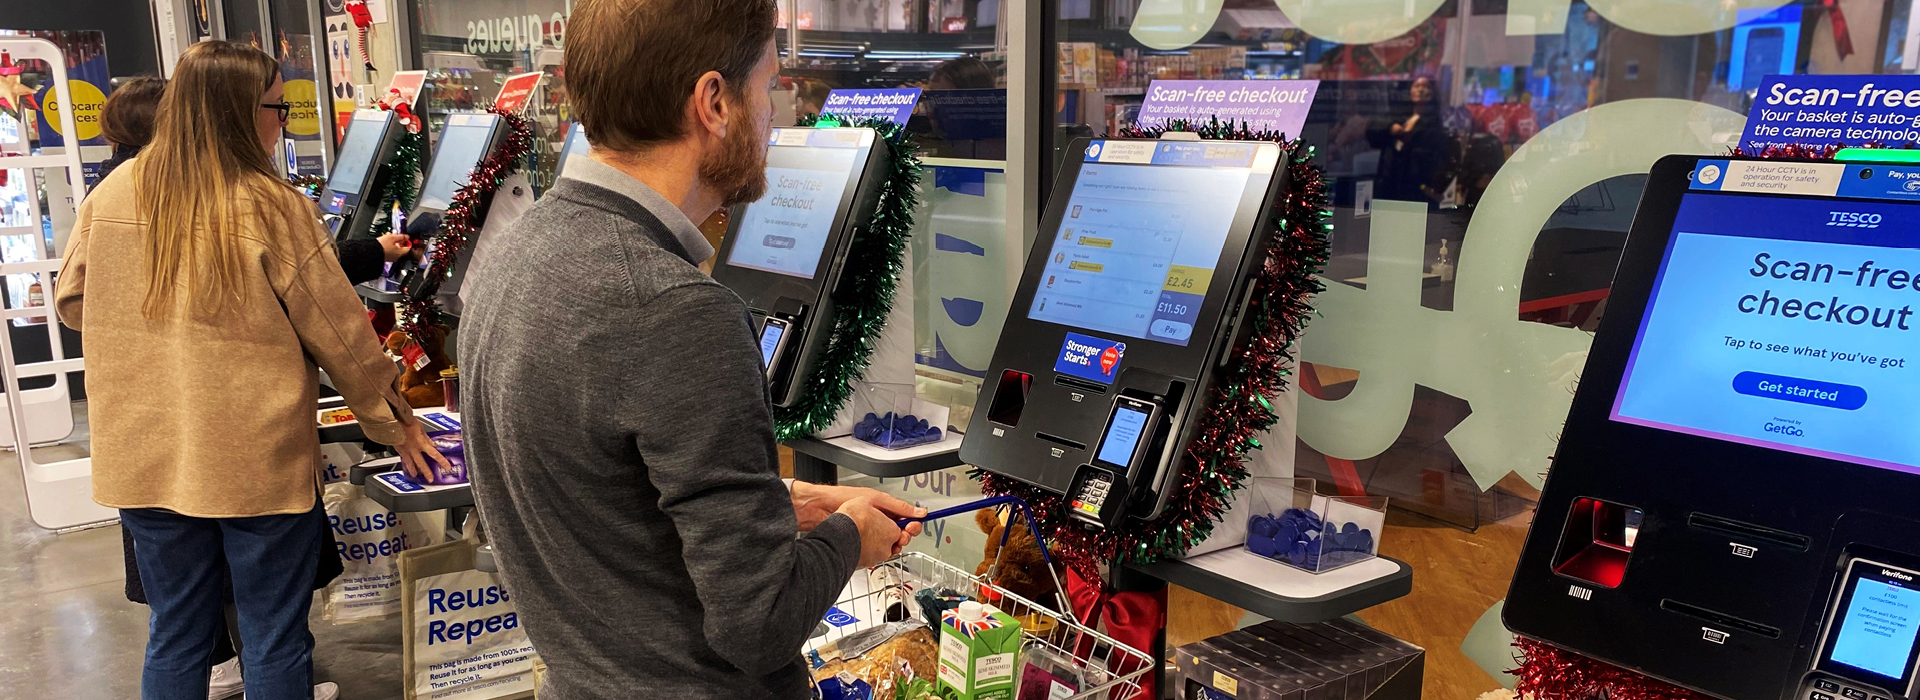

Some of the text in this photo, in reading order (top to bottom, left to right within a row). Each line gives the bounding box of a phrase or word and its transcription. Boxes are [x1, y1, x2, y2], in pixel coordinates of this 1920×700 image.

[827, 92, 915, 105] Scan-free checkout
[1151, 86, 1226, 102] Scan-free
[1228, 86, 1308, 103] checkout
[1766, 82, 1920, 107] Scan-free
[886, 107, 899, 115] using
[1147, 104, 1282, 117] Your basket is auto-generated using
[1760, 109, 1794, 122] Your
[1796, 109, 1847, 123] basket
[1851, 111, 1864, 124] is
[1754, 124, 1779, 137] the
[1782, 126, 1842, 139] camera
[1757, 166, 1776, 174] Hour
[1778, 166, 1799, 174] CCTV
[1809, 167, 1816, 175] in
[777, 175, 822, 191] Scan-free
[1743, 173, 1820, 184] operation for safety
[1756, 181, 1788, 190] security
[771, 193, 814, 210] checkout
[1828, 211, 1882, 226] TESCO
[1166, 277, 1193, 288] £2.45
[1157, 302, 1187, 315] £11.50
[1737, 289, 1914, 331] checkout
[1164, 325, 1177, 336] Pay
[1066, 340, 1101, 357] Stronger
[1724, 336, 1905, 369] Tap to see what you've got
[1758, 380, 1839, 402] Get started
[1763, 422, 1805, 438] GetGo.
[327, 511, 402, 536] Reuse.
[1881, 569, 1913, 582] Verifone
[378, 581, 389, 589] long
[1861, 606, 1878, 615] Please
[428, 611, 518, 646] Repea
[444, 661, 456, 669] bag
[463, 656, 482, 664] made
[483, 652, 499, 660] from
[501, 648, 519, 657] 100%
[430, 672, 450, 680] Reuse
[458, 667, 468, 675] for
[478, 661, 492, 670] long
[501, 659, 514, 667] you
[430, 682, 448, 690] Then
[449, 676, 474, 686] recycle
